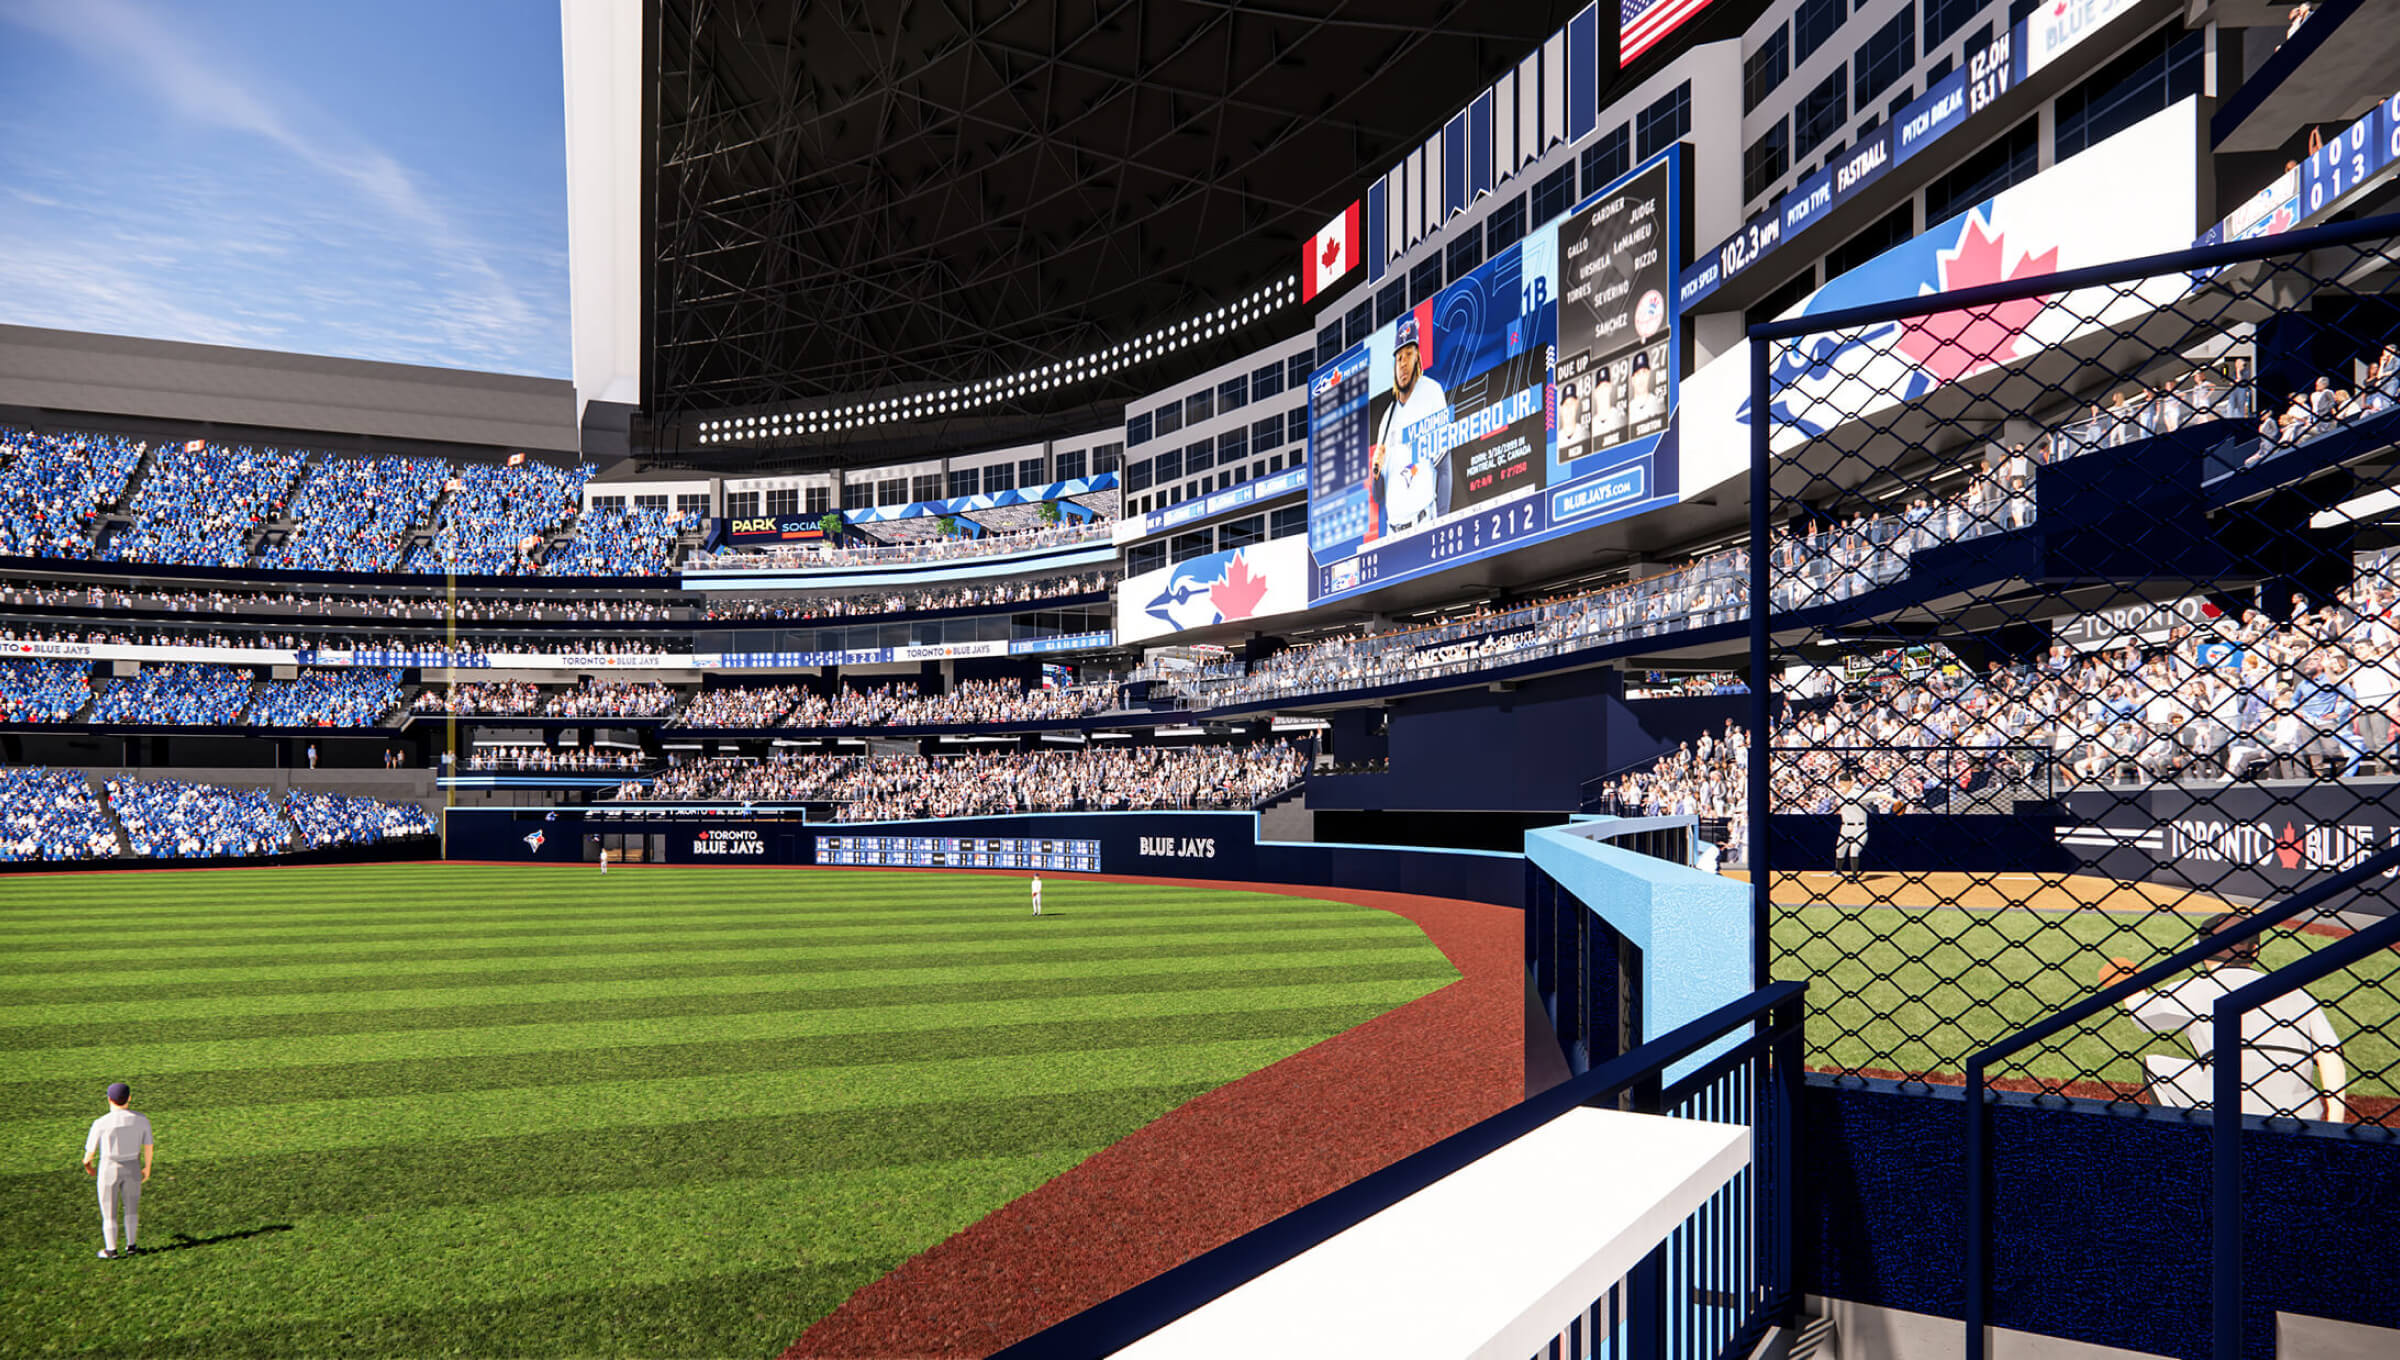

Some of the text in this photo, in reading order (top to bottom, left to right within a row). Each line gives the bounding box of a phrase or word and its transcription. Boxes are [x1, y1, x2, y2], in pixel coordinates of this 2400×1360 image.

[2046, 0, 2097, 50] BLUE
[1969, 77, 1995, 114] 13.1
[1902, 86, 1963, 146] PITCH BREAK
[1837, 140, 1887, 193] FASTBALL
[2312, 150, 2320, 178] 1
[2332, 167, 2341, 196] 1
[2351, 153, 2364, 184] 3
[1591, 196, 1625, 227] GARDNER
[1629, 198, 1656, 225] JUDGE
[1787, 181, 1831, 228] PITCH TYPE
[1567, 237, 1589, 259] GALLO
[1613, 223, 1652, 255] LeMAHIEU
[1720, 217, 1780, 280] 102.3 MPH
[1579, 253, 1612, 280] URSHELA
[1634, 249, 1657, 272] RIZZO
[1521, 275, 1547, 315] 1B
[1567, 281, 1592, 304] TORRES
[1594, 279, 1629, 308] SEVERINO
[1680, 264, 1719, 303] PITCH SPEED
[1595, 313, 1628, 338] SANCHEZ
[1557, 354, 1589, 381] DUE UP
[1650, 343, 1667, 370] 27
[1611, 360, 1628, 386] 99
[1407, 408, 1449, 439] VLADIMIR
[1418, 388, 1537, 461] GUERRERO JR.
[1507, 443, 1531, 461] CANADA
[1563, 480, 1631, 512] BLUEJAYS.COM
[732, 518, 821, 532] PARK SOCIAL
[2083, 597, 2199, 638] TORONTO
[34, 644, 61, 654] BLUE
[64, 645, 90, 655] JAYS
[562, 657, 660, 665] TORONTO BLUE JAYS
[906, 644, 990, 658] TORONTO BLUE JAYS
[693, 840, 764, 854] BLUE JAYS
[709, 830, 757, 840] TORONTO
[1139, 836, 1215, 858] BLUE JAYS
[2168, 820, 2275, 866] TORONTO
[2304, 824, 2374, 873] BLUE
